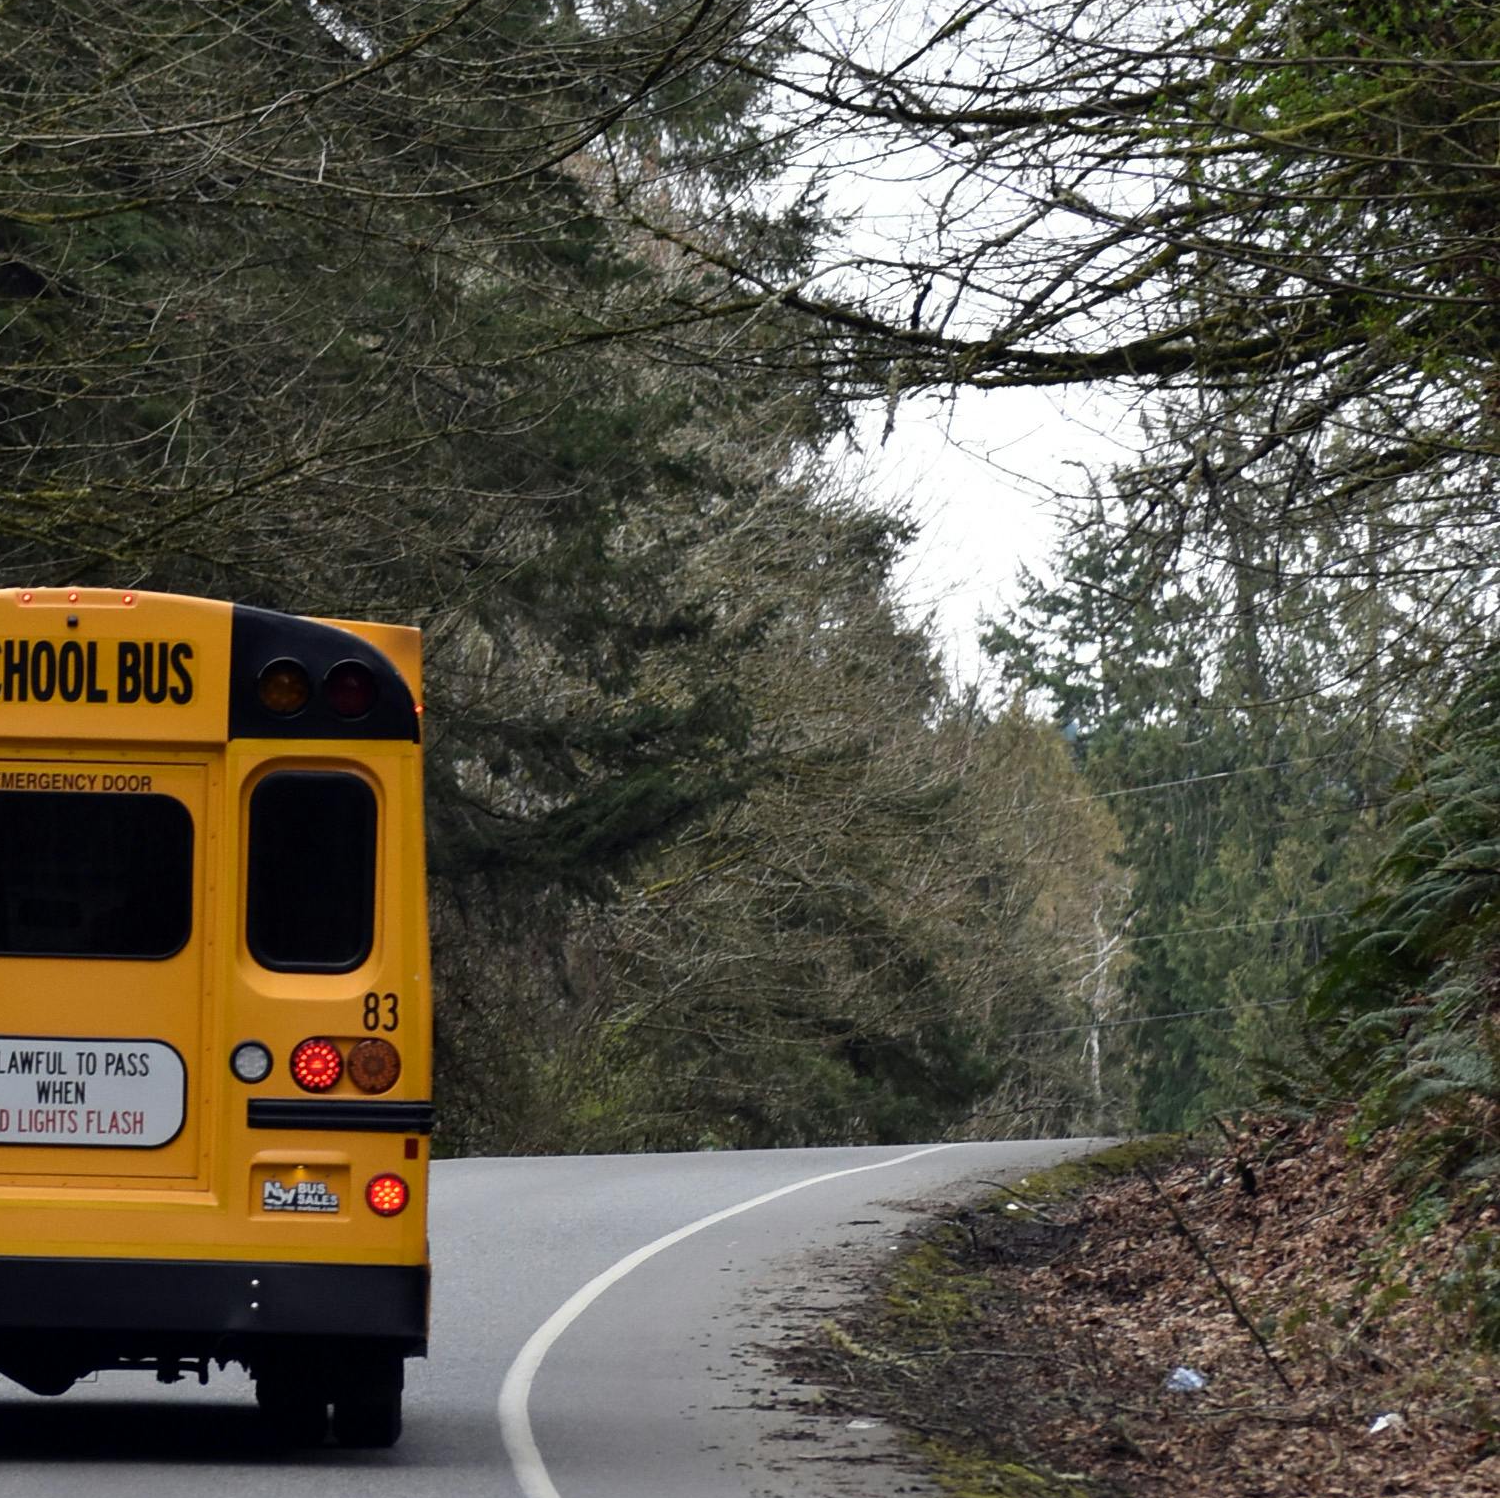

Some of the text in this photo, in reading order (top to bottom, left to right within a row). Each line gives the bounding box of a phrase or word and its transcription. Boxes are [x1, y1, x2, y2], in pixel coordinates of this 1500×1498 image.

[117, 641, 194, 705] BUS
[102, 774, 152, 792] DOOR
[363, 992, 399, 1032] 83
[76, 1052, 98, 1076] TO
[105, 1052, 150, 1077] PASS
[36, 1080, 87, 1105] WHEN
[17, 1109, 78, 1134] LIGHTS
[86, 1110, 145, 1135] FLASH
[296, 1193, 338, 1206] SALES
[297, 1183, 326, 1194] BUS
